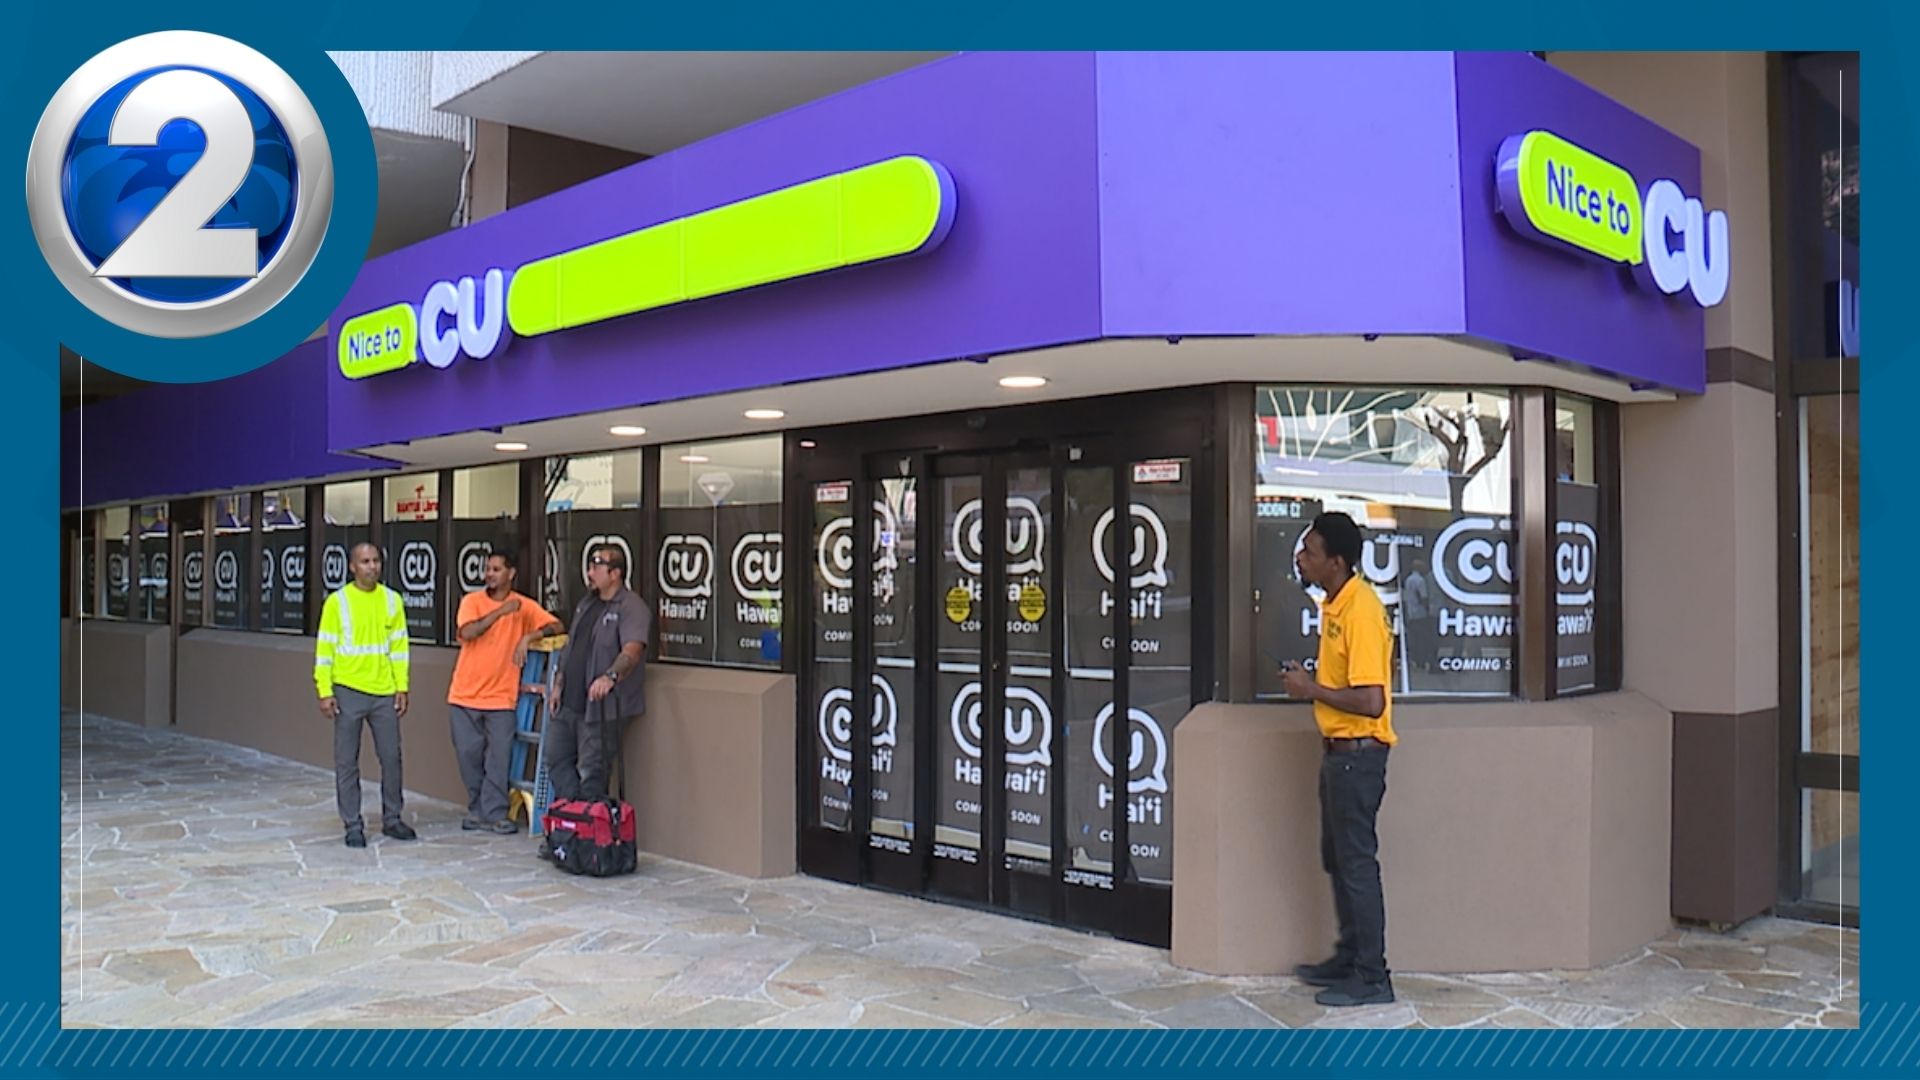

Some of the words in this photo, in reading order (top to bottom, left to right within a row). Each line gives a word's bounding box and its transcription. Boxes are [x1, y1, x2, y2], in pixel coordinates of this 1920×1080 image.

[1547, 159, 1601, 223] Nice
[1608, 190, 1631, 235] to
[1644, 178, 1729, 307] CU
[420, 267, 504, 369] CU
[349, 332, 382, 363] Nice
[386, 325, 401, 352] to
[405, 553, 429, 579] CU
[667, 549, 703, 582] CU
[743, 549, 783, 584] CU
[1556, 541, 1591, 585] CU
[1006, 621, 1040, 634] SOON
[1130, 639, 1160, 653] OON
[1439, 657, 1501, 672] COMING
[1010, 809, 1042, 826] SOON
[1129, 843, 1160, 859] OON
